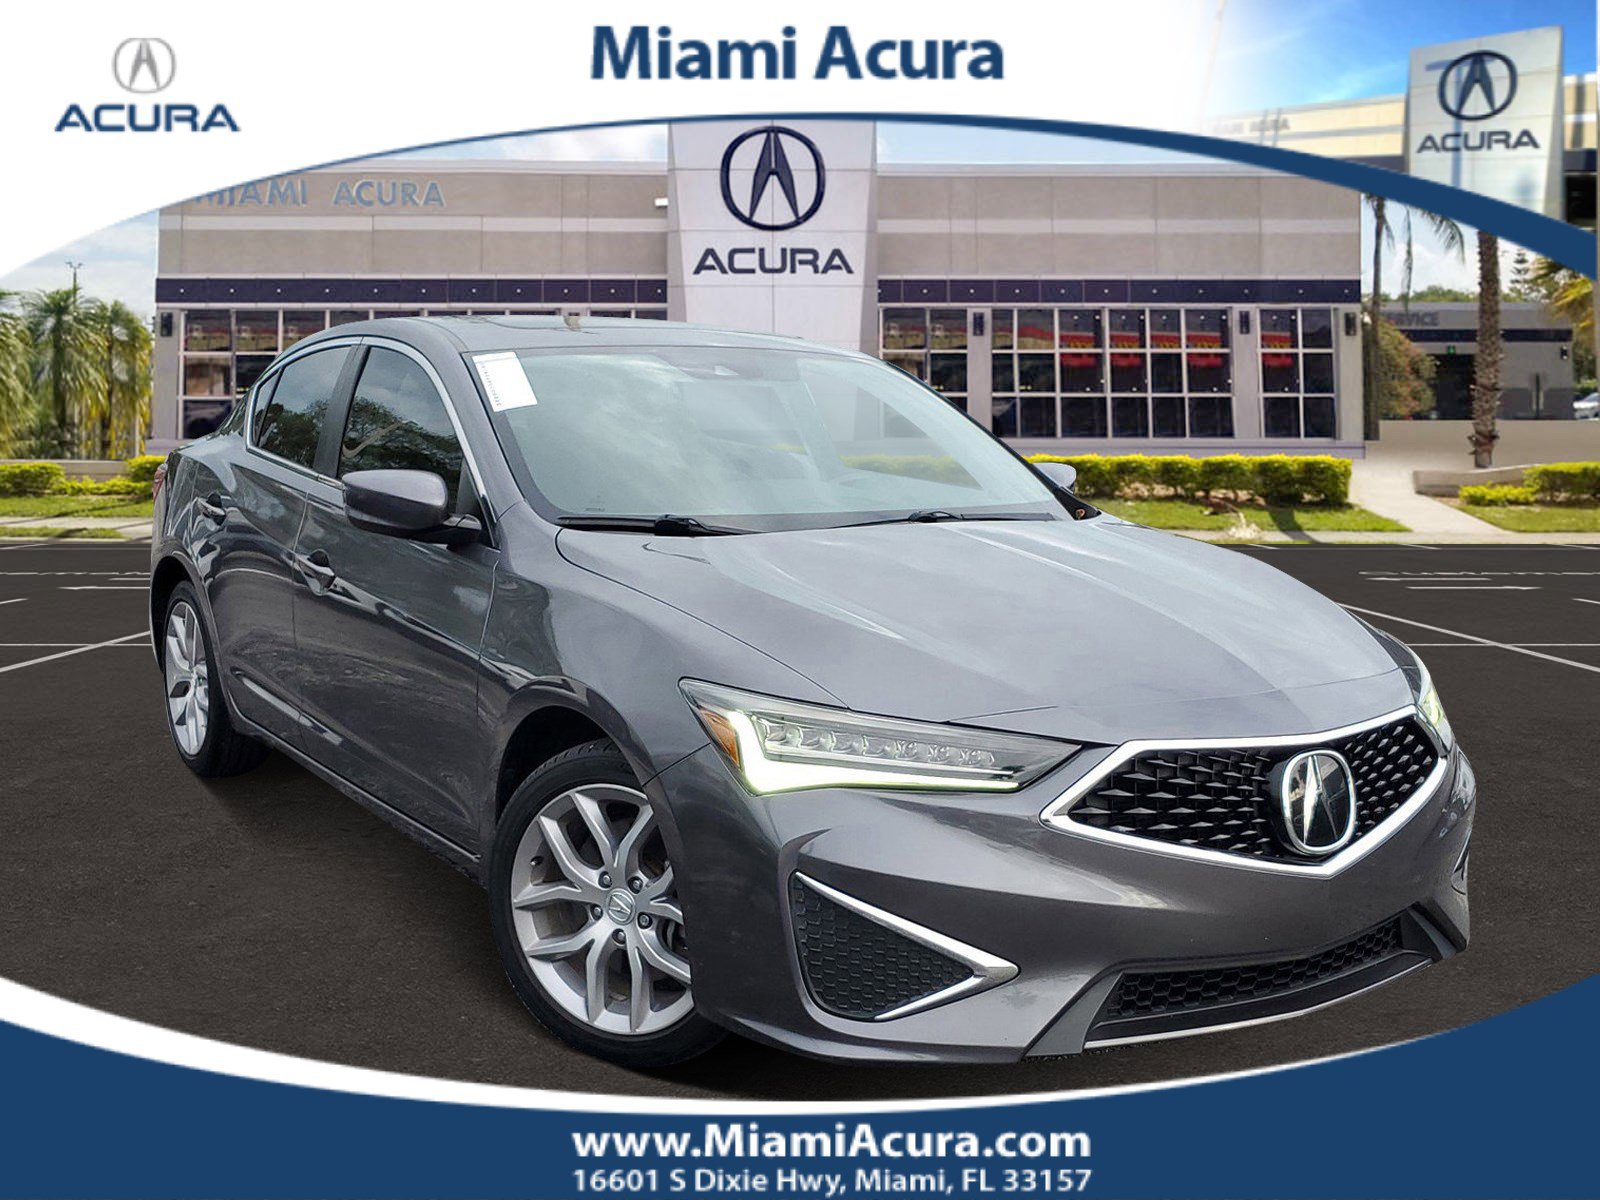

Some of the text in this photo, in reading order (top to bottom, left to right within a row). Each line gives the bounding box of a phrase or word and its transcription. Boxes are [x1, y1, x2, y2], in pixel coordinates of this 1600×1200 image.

[1416, 129, 1540, 154] ACURA
[332, 178, 446, 208] ACURA
[692, 247, 854, 275] ACURA
